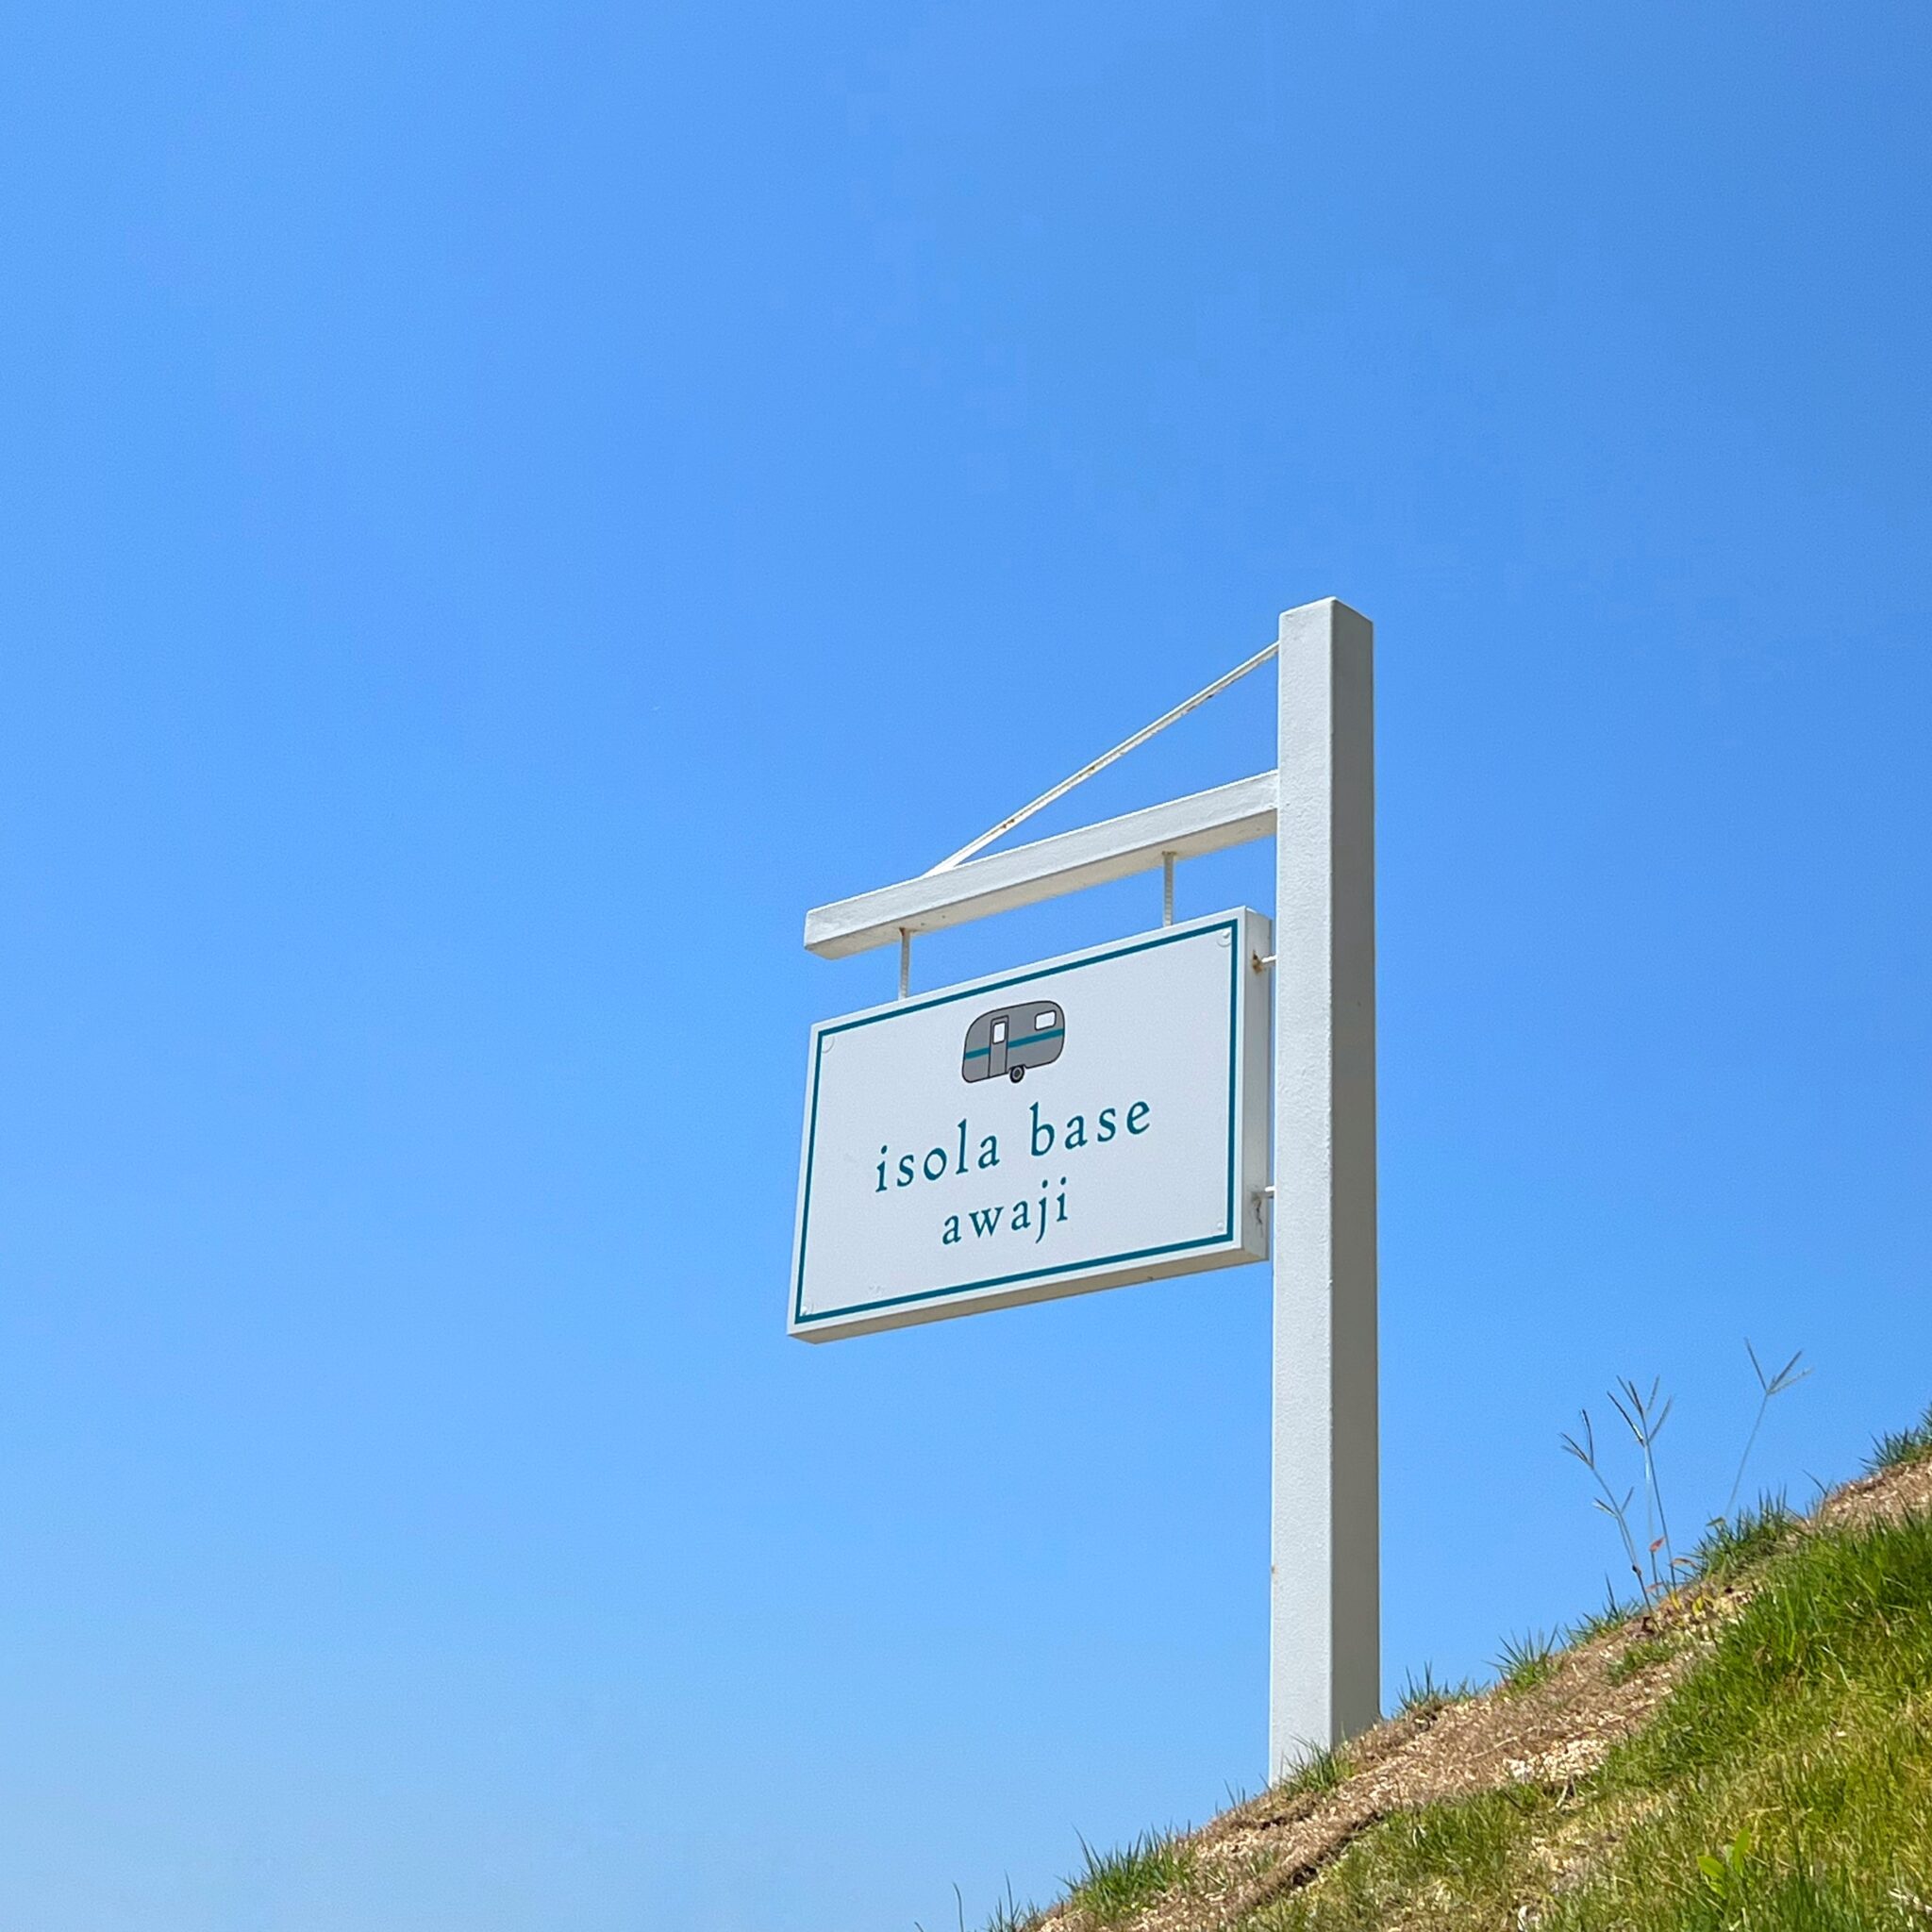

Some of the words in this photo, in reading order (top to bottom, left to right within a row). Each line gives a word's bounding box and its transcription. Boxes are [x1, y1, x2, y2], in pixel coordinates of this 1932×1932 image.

[874, 1118, 1001, 1193] isola
[1029, 1100, 1151, 1157] base
[941, 1176, 1068, 1244] awaji
